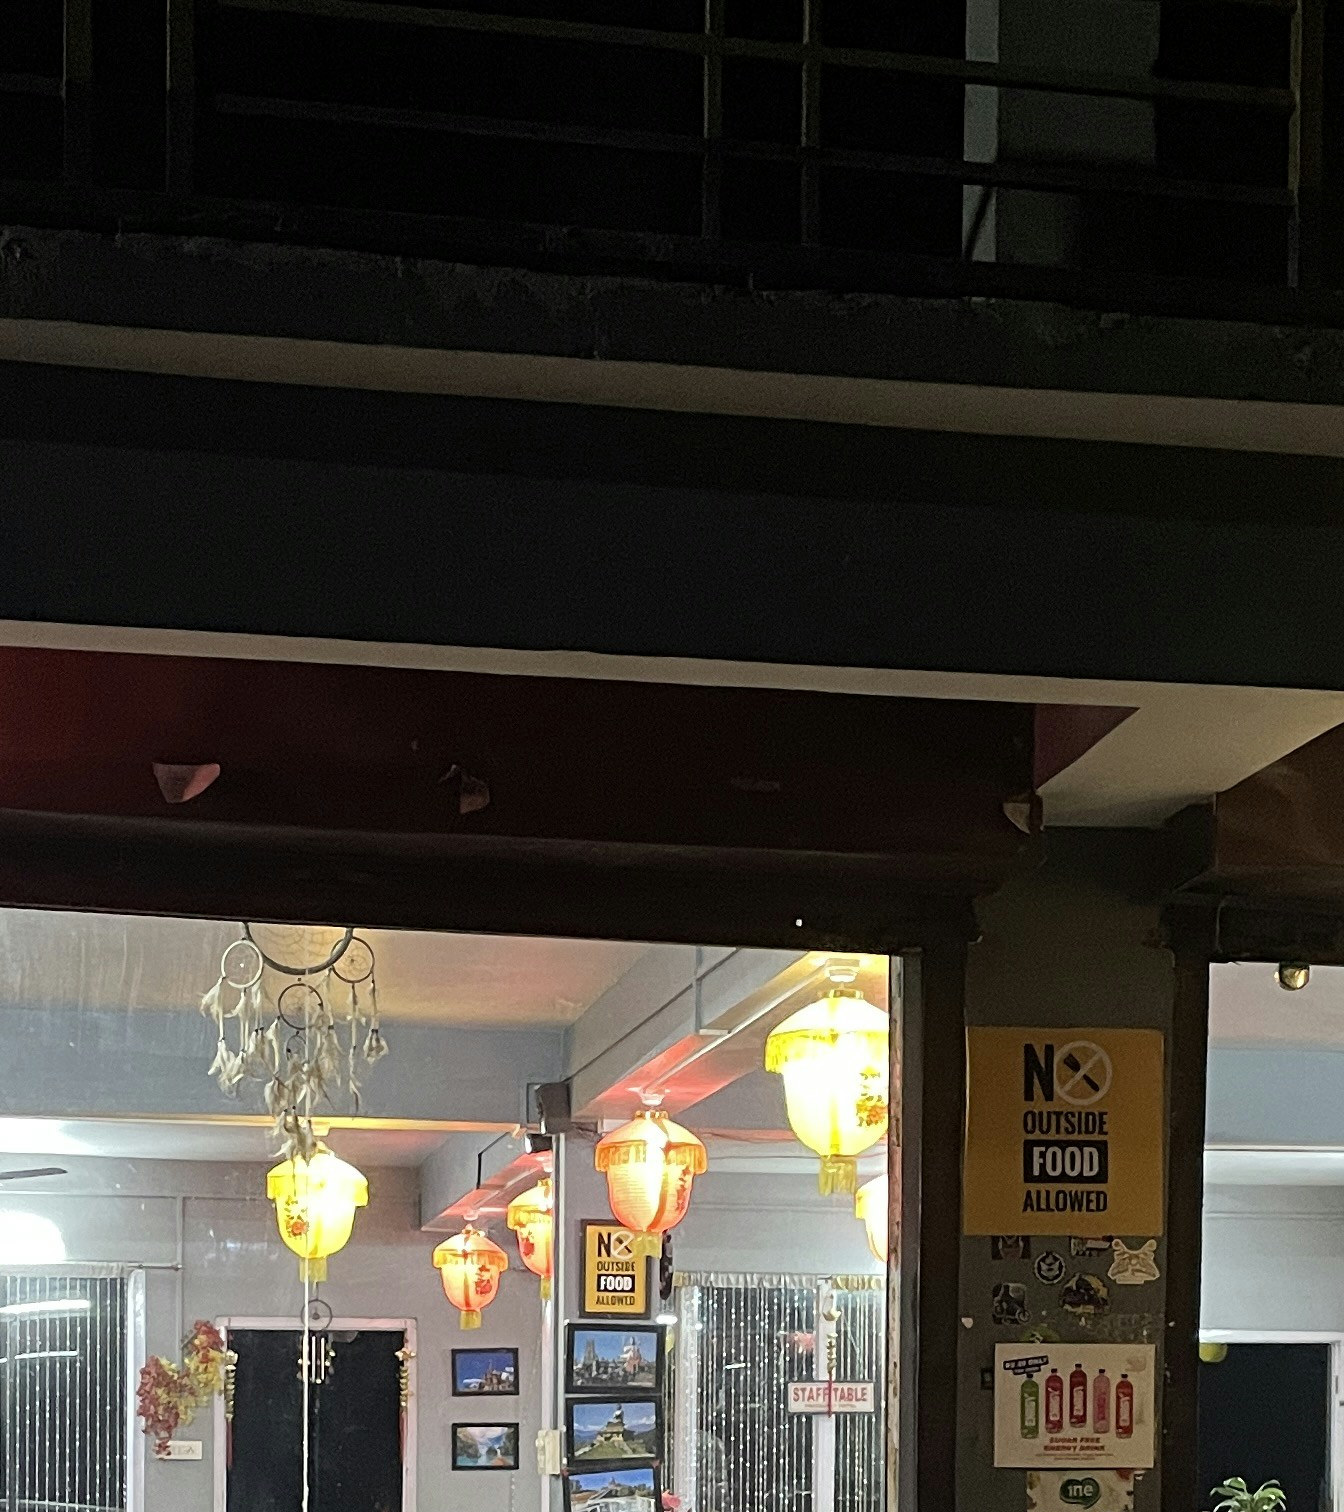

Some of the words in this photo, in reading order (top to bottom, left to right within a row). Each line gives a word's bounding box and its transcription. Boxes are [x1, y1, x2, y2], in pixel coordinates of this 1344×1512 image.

[1023, 1111, 1108, 1135] OUTSIDE
[1032, 1146, 1100, 1177] FOOD
[1022, 1189, 1108, 1212] ALLOWED
[596, 1261, 635, 1272] OUTSIDE
[600, 1275, 633, 1291] FOOD
[596, 1295, 635, 1306] ALLOWED
[793, 1387, 829, 1402] STAFF
[832, 1387, 867, 1402] TABLE
